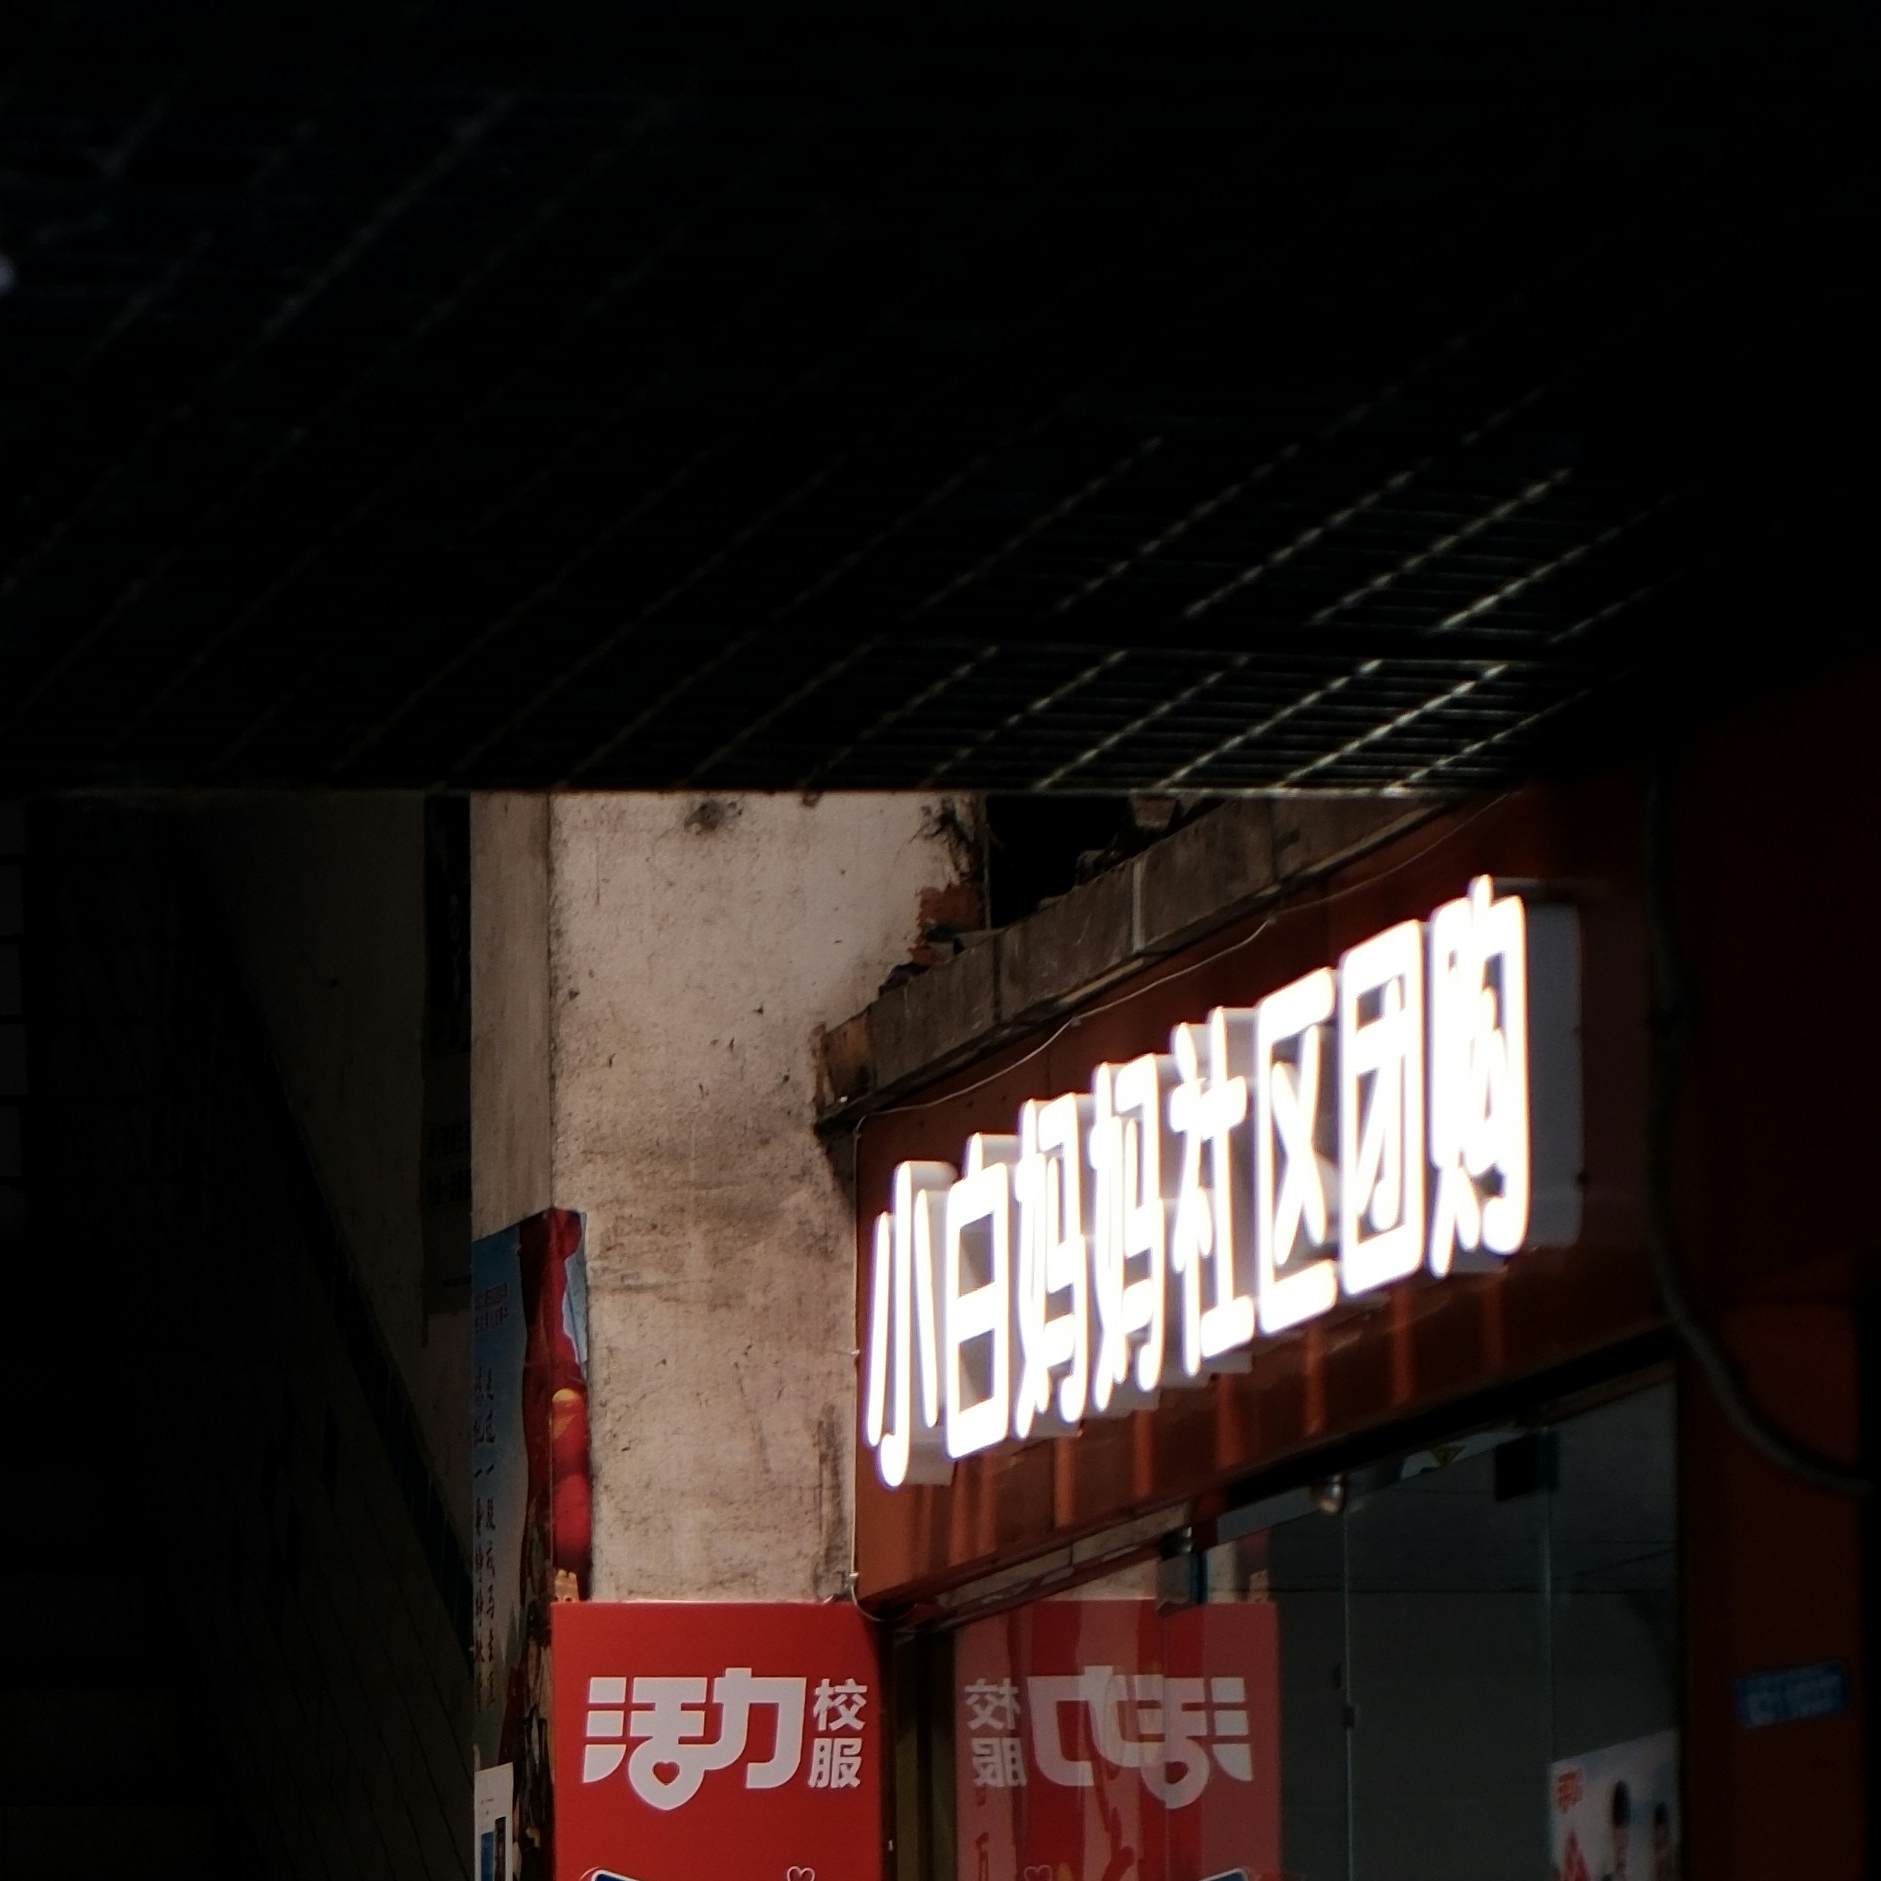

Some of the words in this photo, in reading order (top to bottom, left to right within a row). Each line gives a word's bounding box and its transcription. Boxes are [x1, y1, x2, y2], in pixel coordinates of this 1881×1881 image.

[866, 874, 1530, 1489] 小白妈妈社区团购
[582, 1667, 807, 1811] 活力
[808, 1677, 868, 1789] 校服
